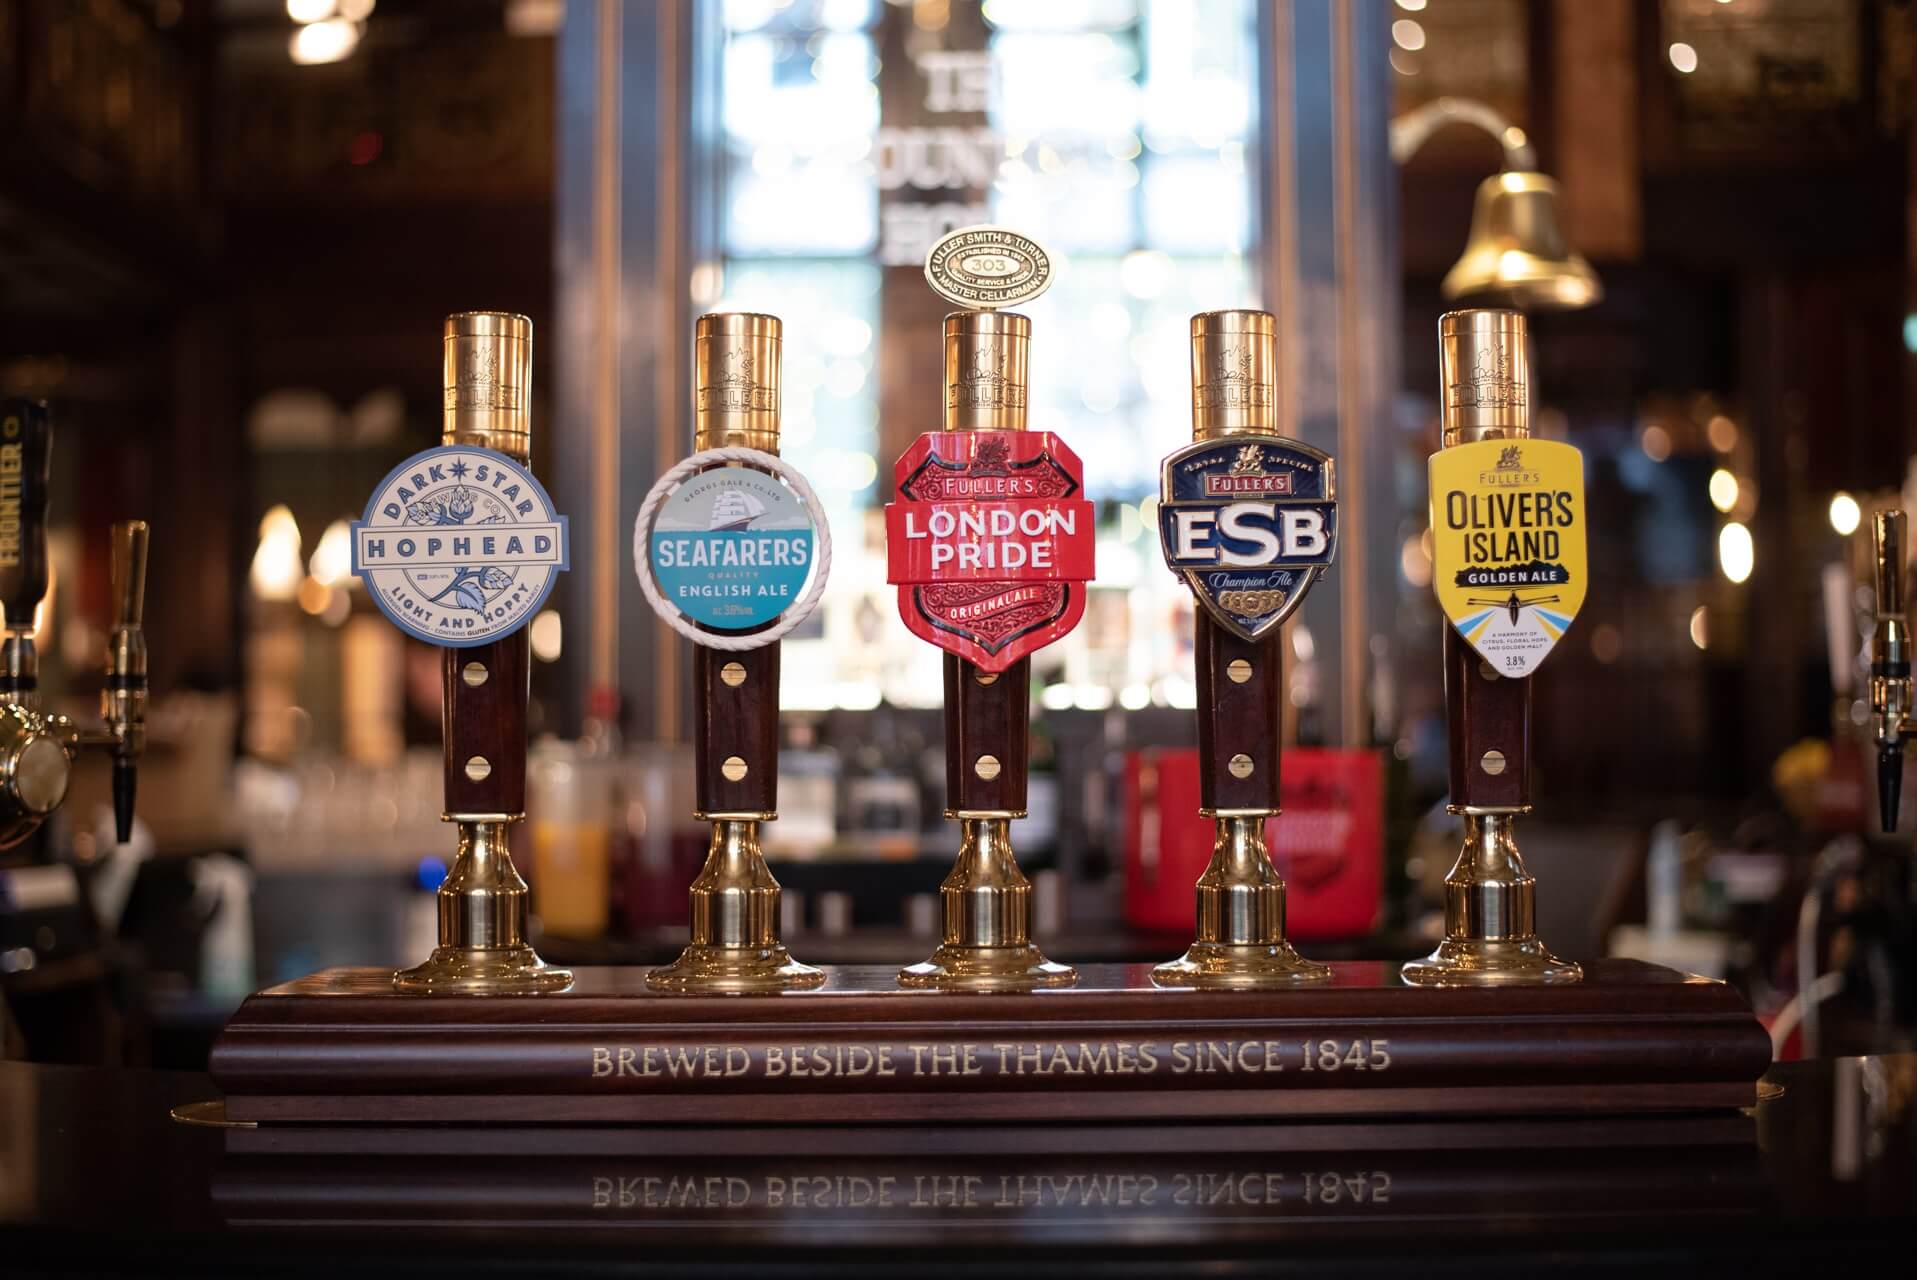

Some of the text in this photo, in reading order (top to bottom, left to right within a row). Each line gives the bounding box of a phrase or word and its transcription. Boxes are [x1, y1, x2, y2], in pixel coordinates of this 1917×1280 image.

[932, 232, 1048, 276] FULLER SMITH & TURNER
[971, 258, 1006, 272] 303
[939, 274, 1041, 301] MASTER CELLARMAN
[0, 442, 22, 568] FRONTIER
[383, 463, 534, 521] DARK STAR
[684, 482, 718, 503] GEORGE
[720, 479, 743, 487] GALE
[905, 508, 1076, 539] LONDON
[1446, 489, 1574, 531] OLIVER'S
[368, 535, 552, 558] HOPHEAD
[1175, 502, 1328, 566] ESB
[1463, 530, 1560, 564] ISLAND
[658, 538, 808, 568] SEAFARERS
[931, 541, 1053, 571] PRIDE
[707, 571, 760, 580] QUALITY
[1209, 570, 1293, 592] Champion Ale
[1468, 570, 1558, 584] GOLDEN ALE
[679, 583, 788, 597] ENGLISH ALE
[391, 583, 529, 630] LIGHT AND HOPPY
[950, 594, 1012, 620] ORIGINAL
[435, 628, 466, 637] CONTAINS
[467, 626, 491, 636] GLUTEN
[1506, 655, 1526, 666] 3.8%
[592, 1038, 1393, 1078] BREWED BESIDE THE THAMES SINCE 1845
